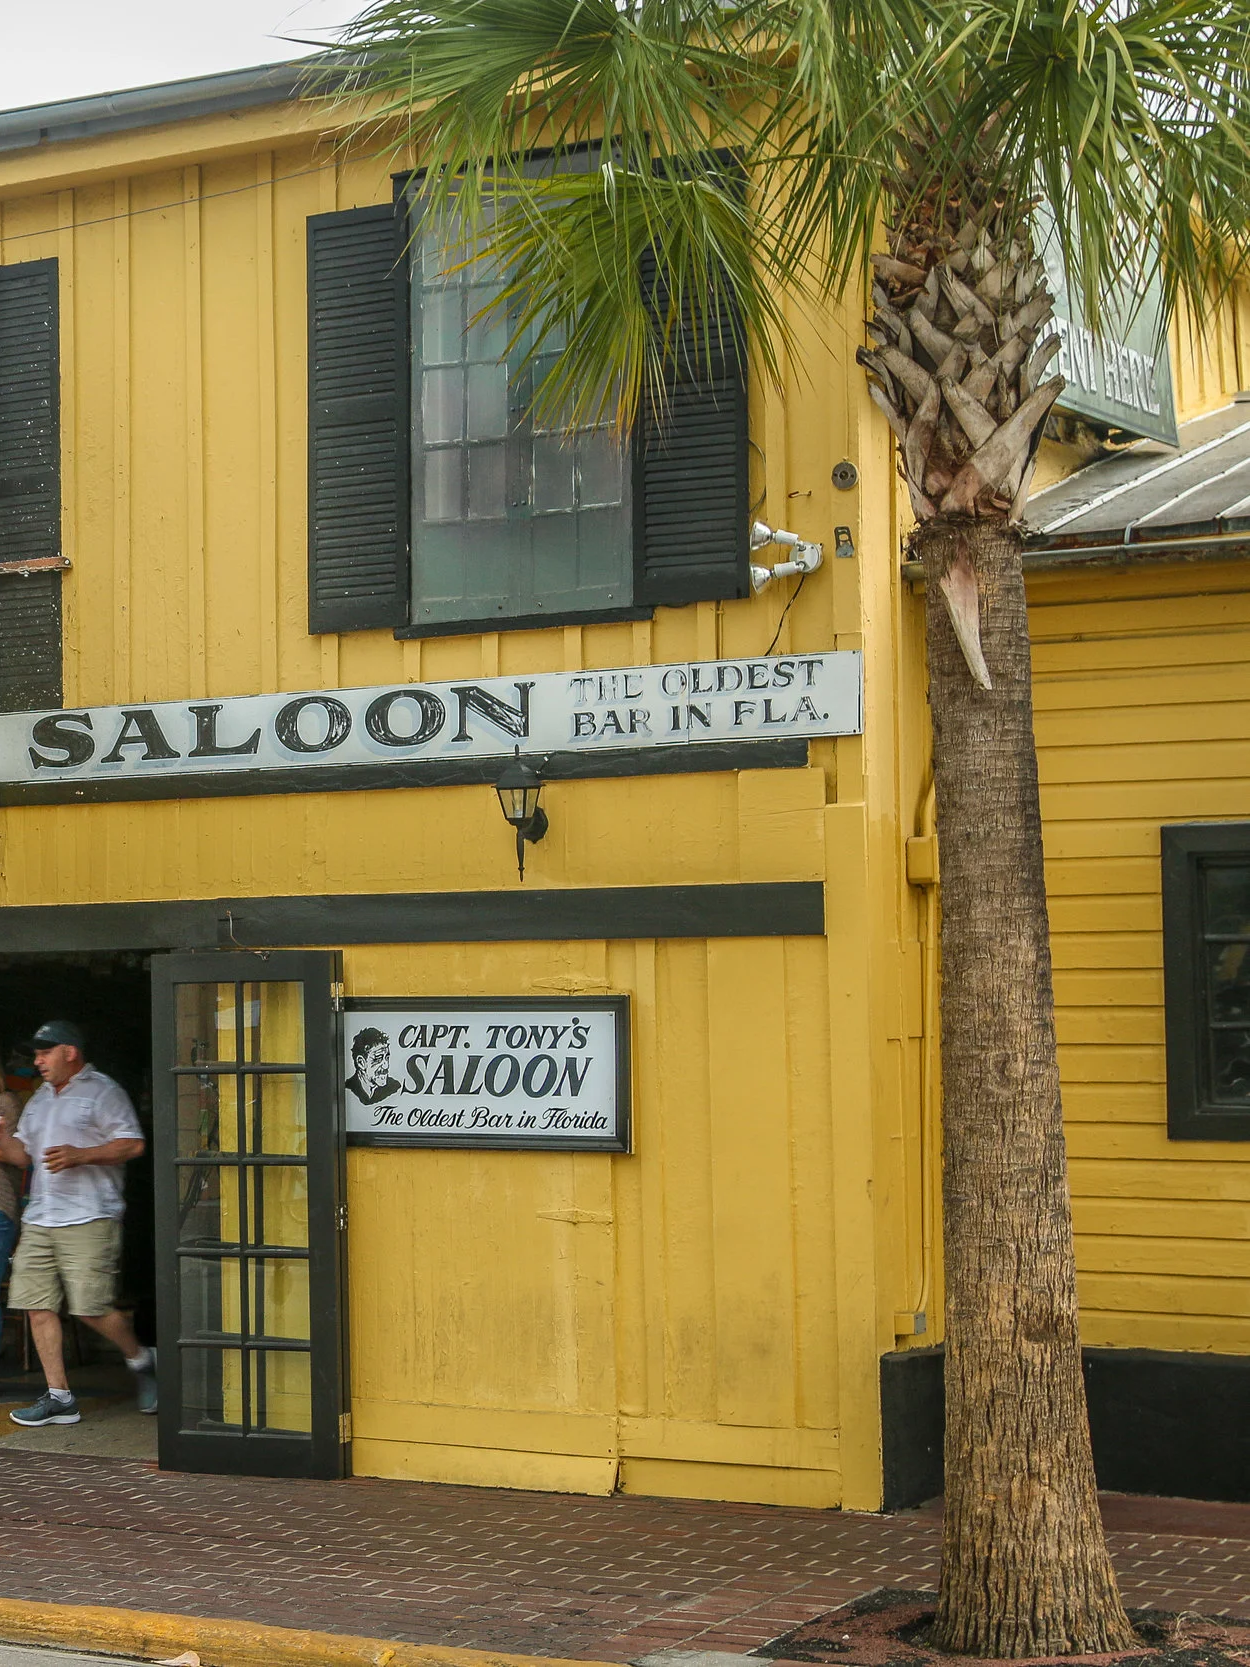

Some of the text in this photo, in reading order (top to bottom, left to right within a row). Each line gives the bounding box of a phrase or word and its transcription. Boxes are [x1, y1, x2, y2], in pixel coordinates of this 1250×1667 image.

[569, 659, 824, 703] THE OLDEST
[29, 680, 536, 770] SALOON
[572, 696, 830, 737] BAR IN FLA.
[398, 1017, 591, 1050] CAPT. TONY'S
[400, 1053, 593, 1099] SALOON
[370, 1105, 608, 1130] The Oldest Bar in Florida
